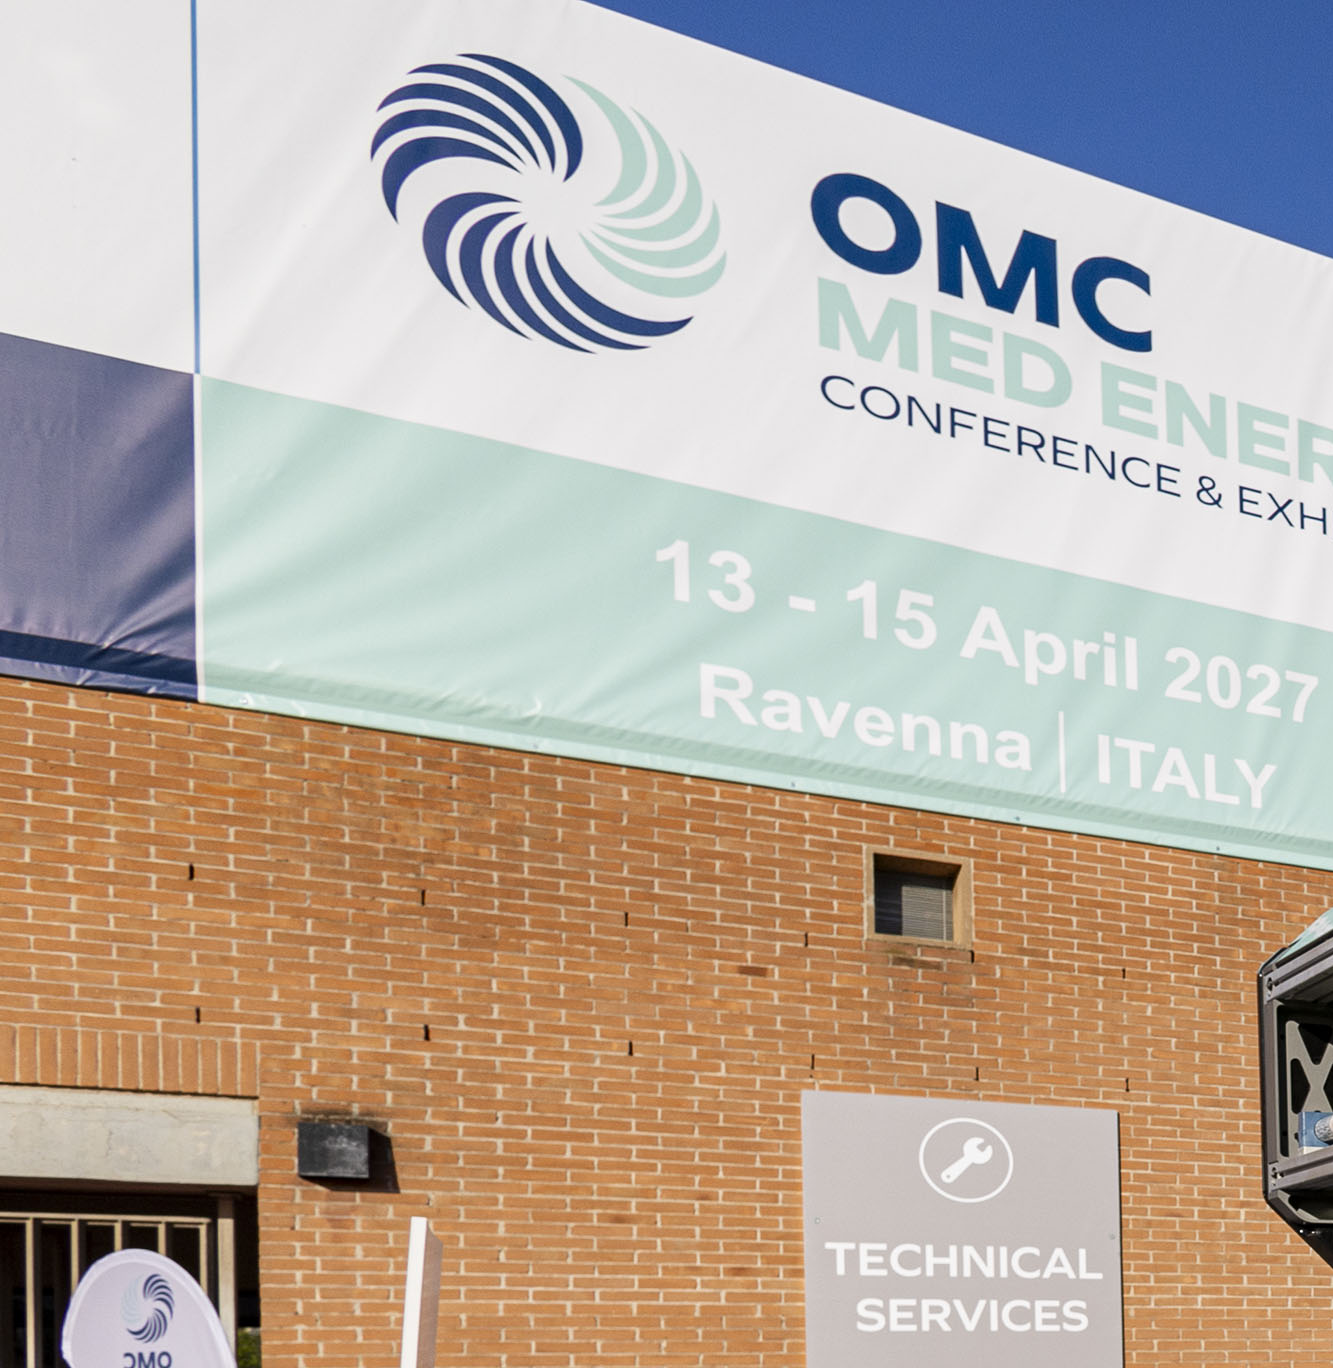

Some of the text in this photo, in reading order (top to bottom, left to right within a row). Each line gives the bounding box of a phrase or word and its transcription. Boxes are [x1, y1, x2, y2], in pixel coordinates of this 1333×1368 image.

[810, 172, 1152, 352] OMC
[817, 276, 1072, 408] MED
[820, 374, 1182, 498] CONFERENCE
[1196, 475, 1224, 510] &
[655, 539, 756, 613] 13
[846, 579, 938, 650] 15
[958, 605, 1138, 690] April
[1163, 646, 1320, 723] 2027
[699, 662, 1033, 772] Ravenna
[1099, 733, 1278, 810] ITALY
[825, 1241, 1103, 1280] TECHNICAL
[856, 1298, 1089, 1332] SERVICES
